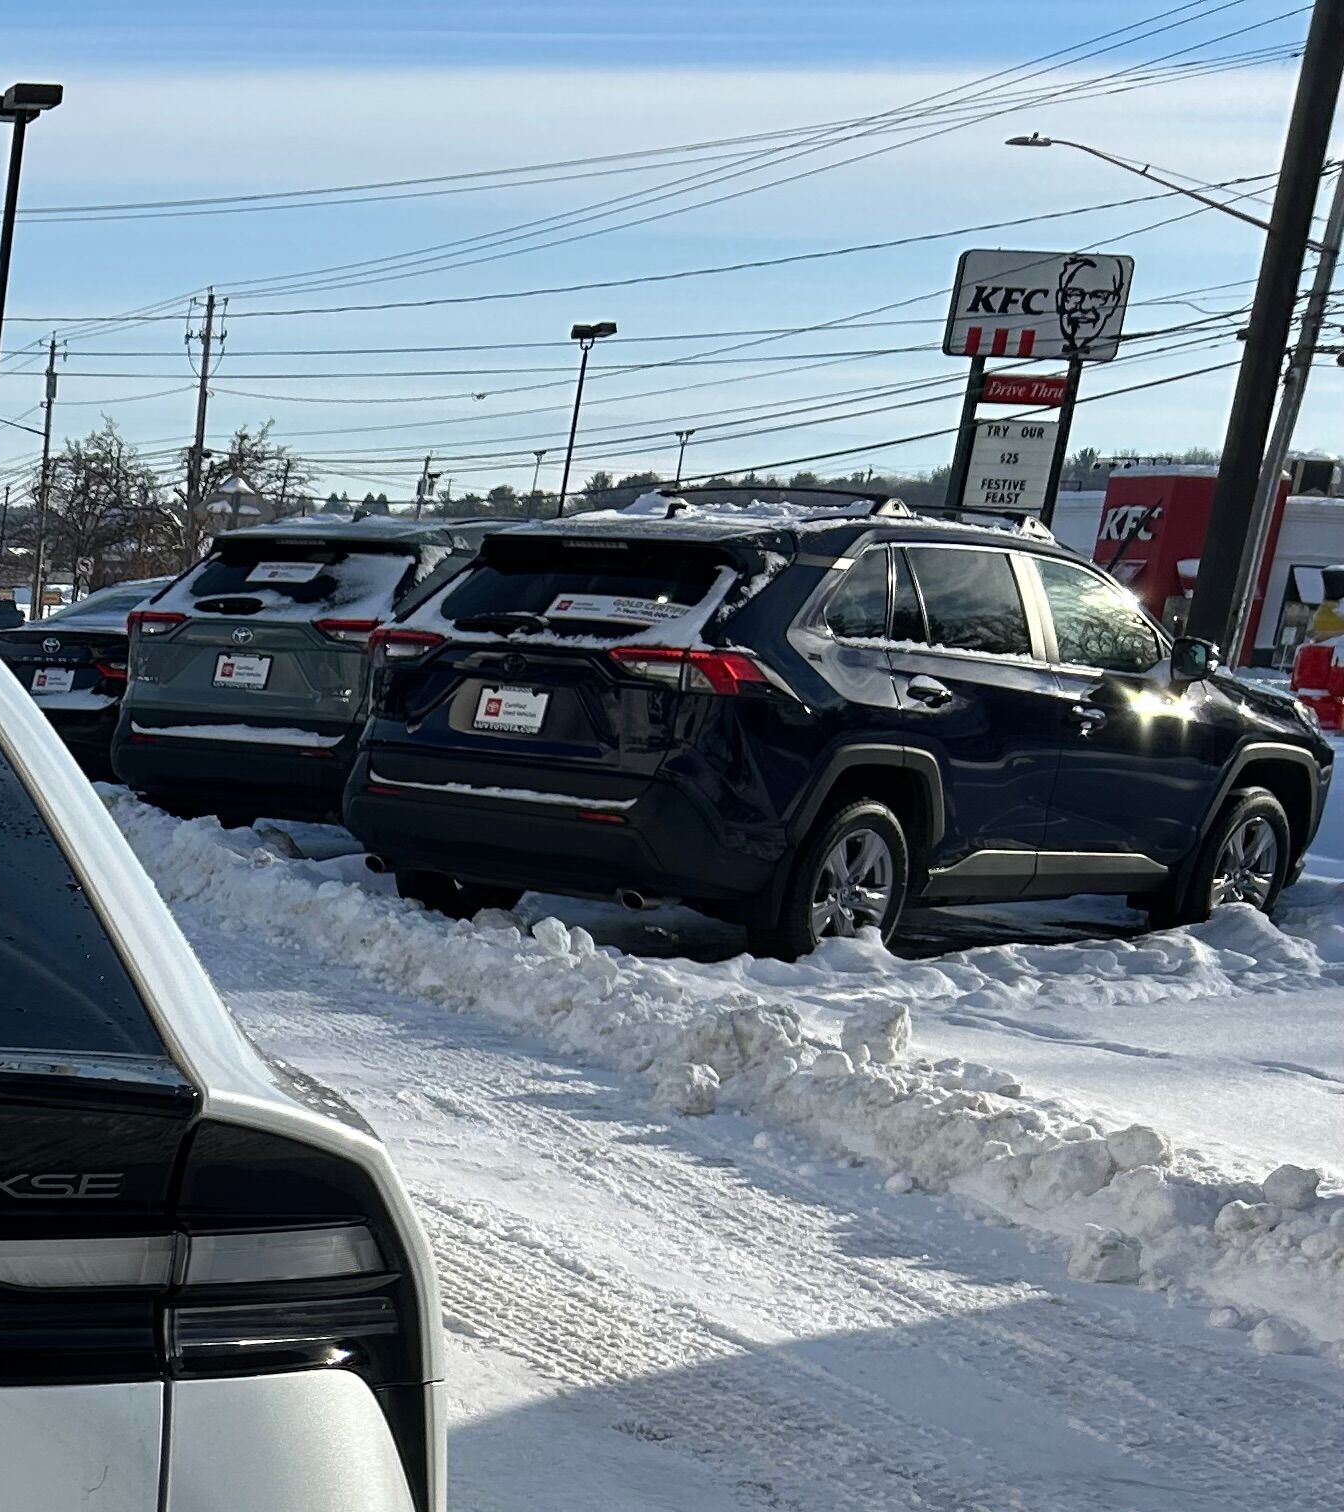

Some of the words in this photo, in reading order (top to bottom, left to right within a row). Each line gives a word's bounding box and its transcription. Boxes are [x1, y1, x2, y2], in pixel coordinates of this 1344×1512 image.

[966, 285, 1050, 316] KFC
[987, 380, 1028, 397] Drive
[1029, 384, 1065, 399] Thru
[986, 424, 1010, 438] TRY
[1020, 426, 1045, 439] OUR
[1000, 452, 1020, 465] $25
[980, 478, 1027, 492] FESTIVE
[984, 491, 1022, 505] FEAST
[612, 599, 644, 610] GOLD
